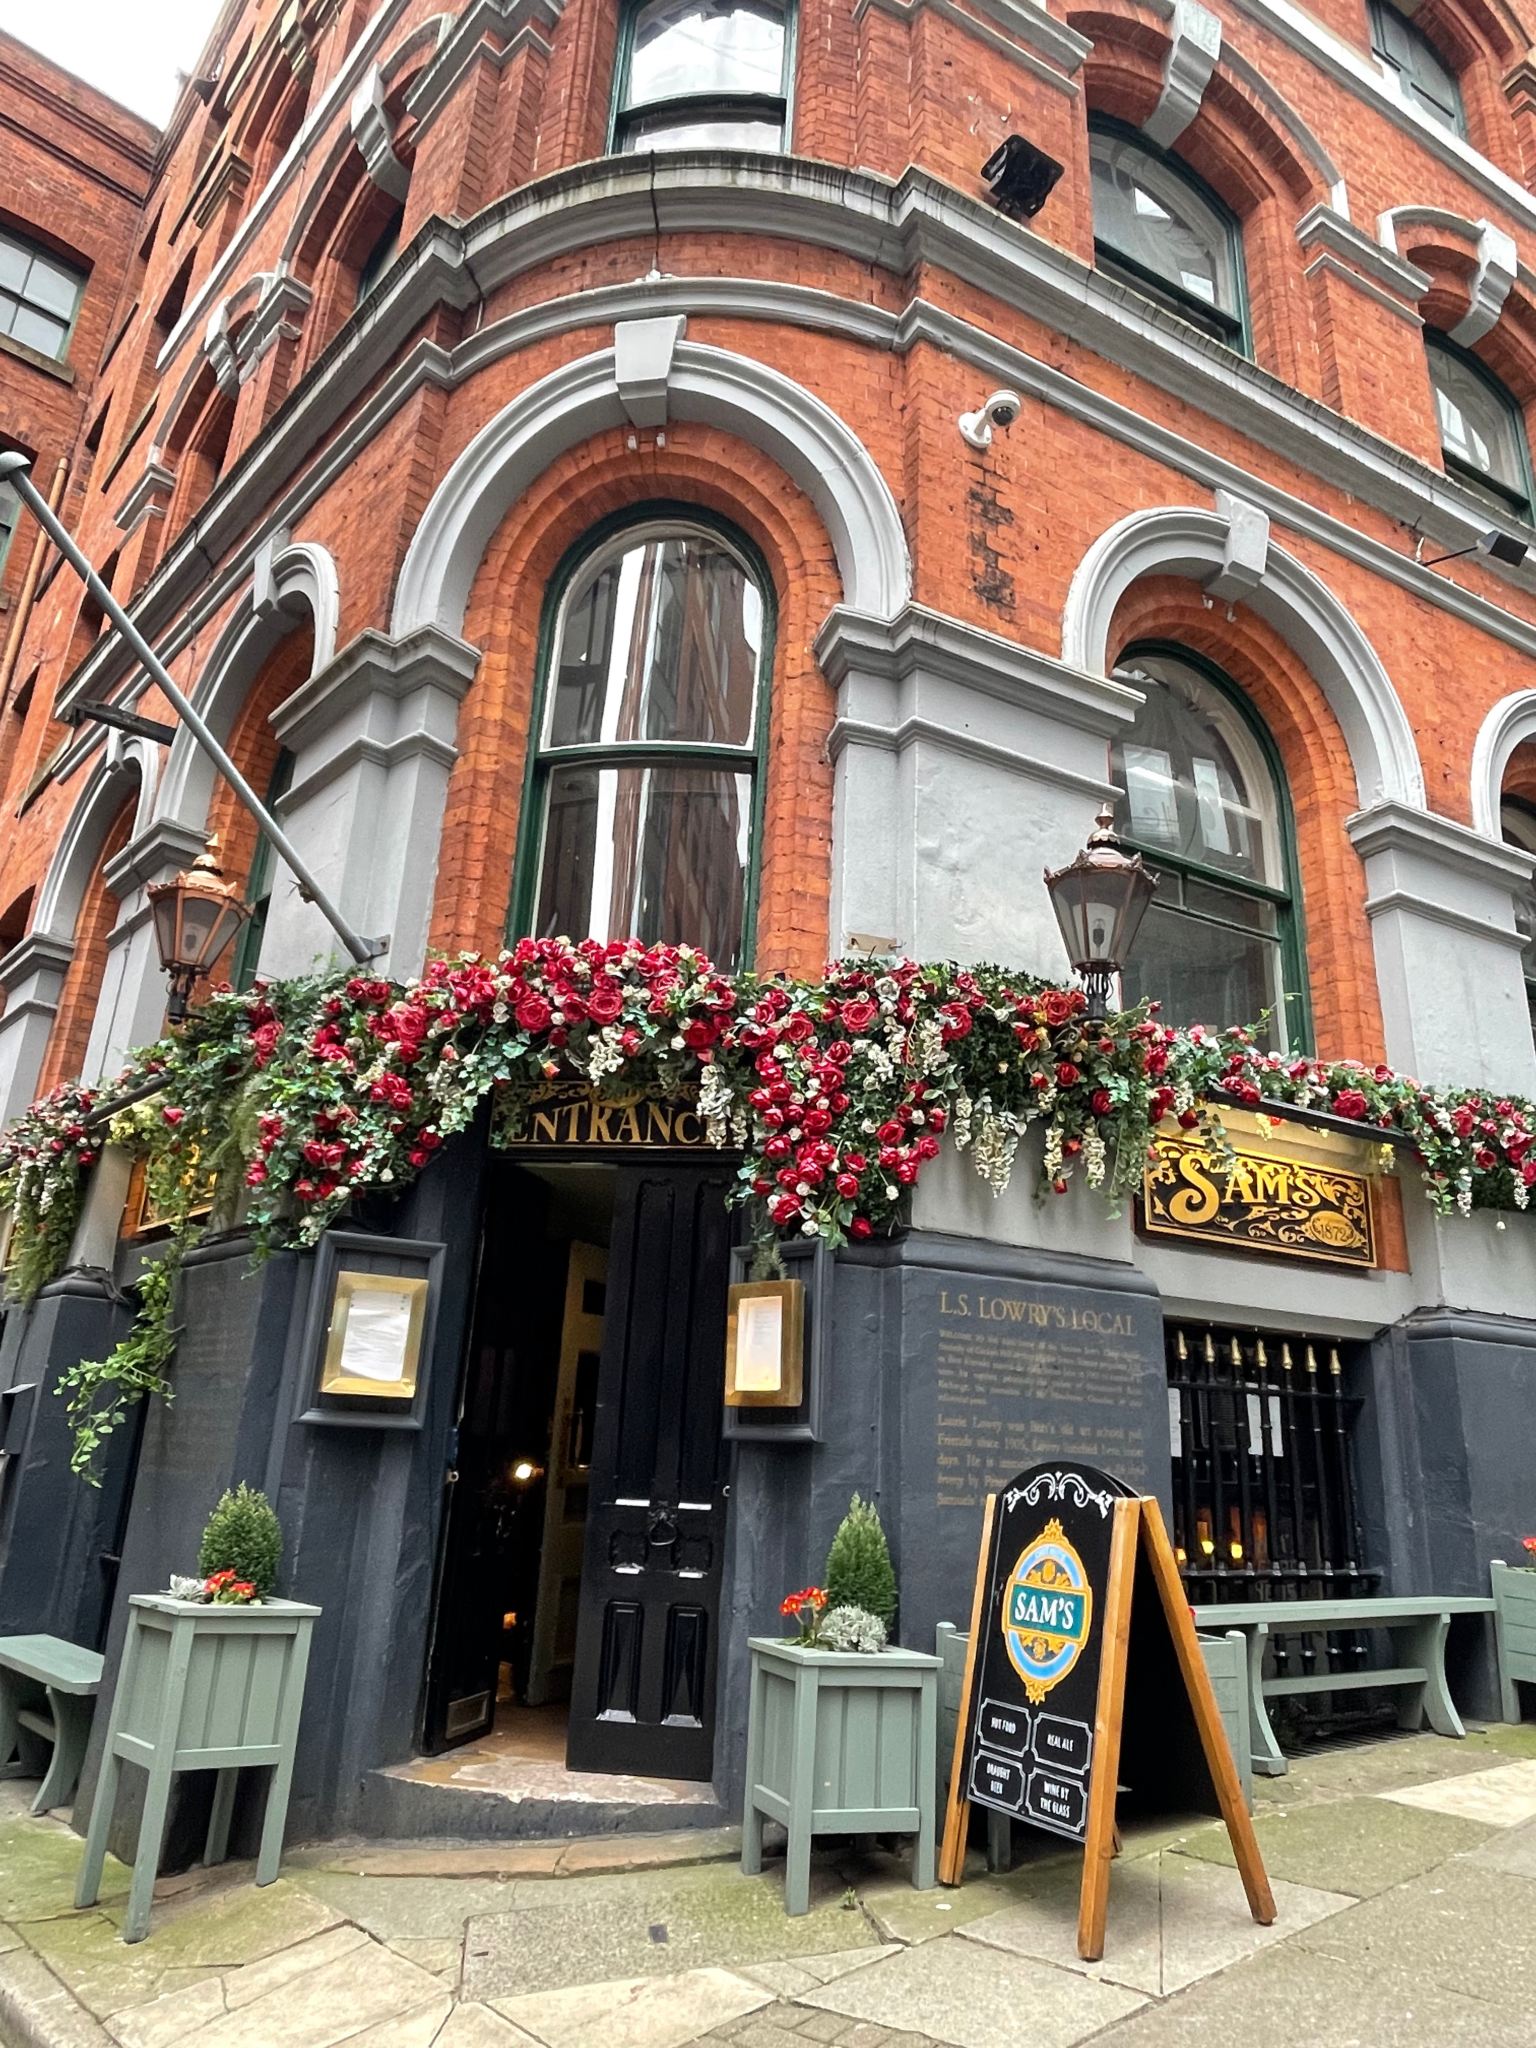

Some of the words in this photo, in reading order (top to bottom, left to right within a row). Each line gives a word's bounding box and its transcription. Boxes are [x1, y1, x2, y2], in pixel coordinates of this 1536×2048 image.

[1320, 1221, 1348, 1242] 1872
[940, 1291, 972, 1317] L.S.
[978, 1296, 1066, 1328] LOWRY'S
[1072, 1309, 1137, 1337] LOCAL
[1014, 1591, 1075, 1630] SAM'S
[990, 1717, 1003, 1730] HOT
[1002, 1719, 1017, 1734] FOOD
[1046, 1734, 1062, 1749] REAL
[1061, 1738, 1074, 1752] ALE
[986, 1763, 1011, 1780] DRAUGHT
[990, 1780, 1003, 1795] BEER
[1044, 1780, 1060, 1798] WINE
[1060, 1787, 1070, 1801] BY
[1040, 1797, 1052, 1813] THE
[1052, 1801, 1071, 1819] GLASS
